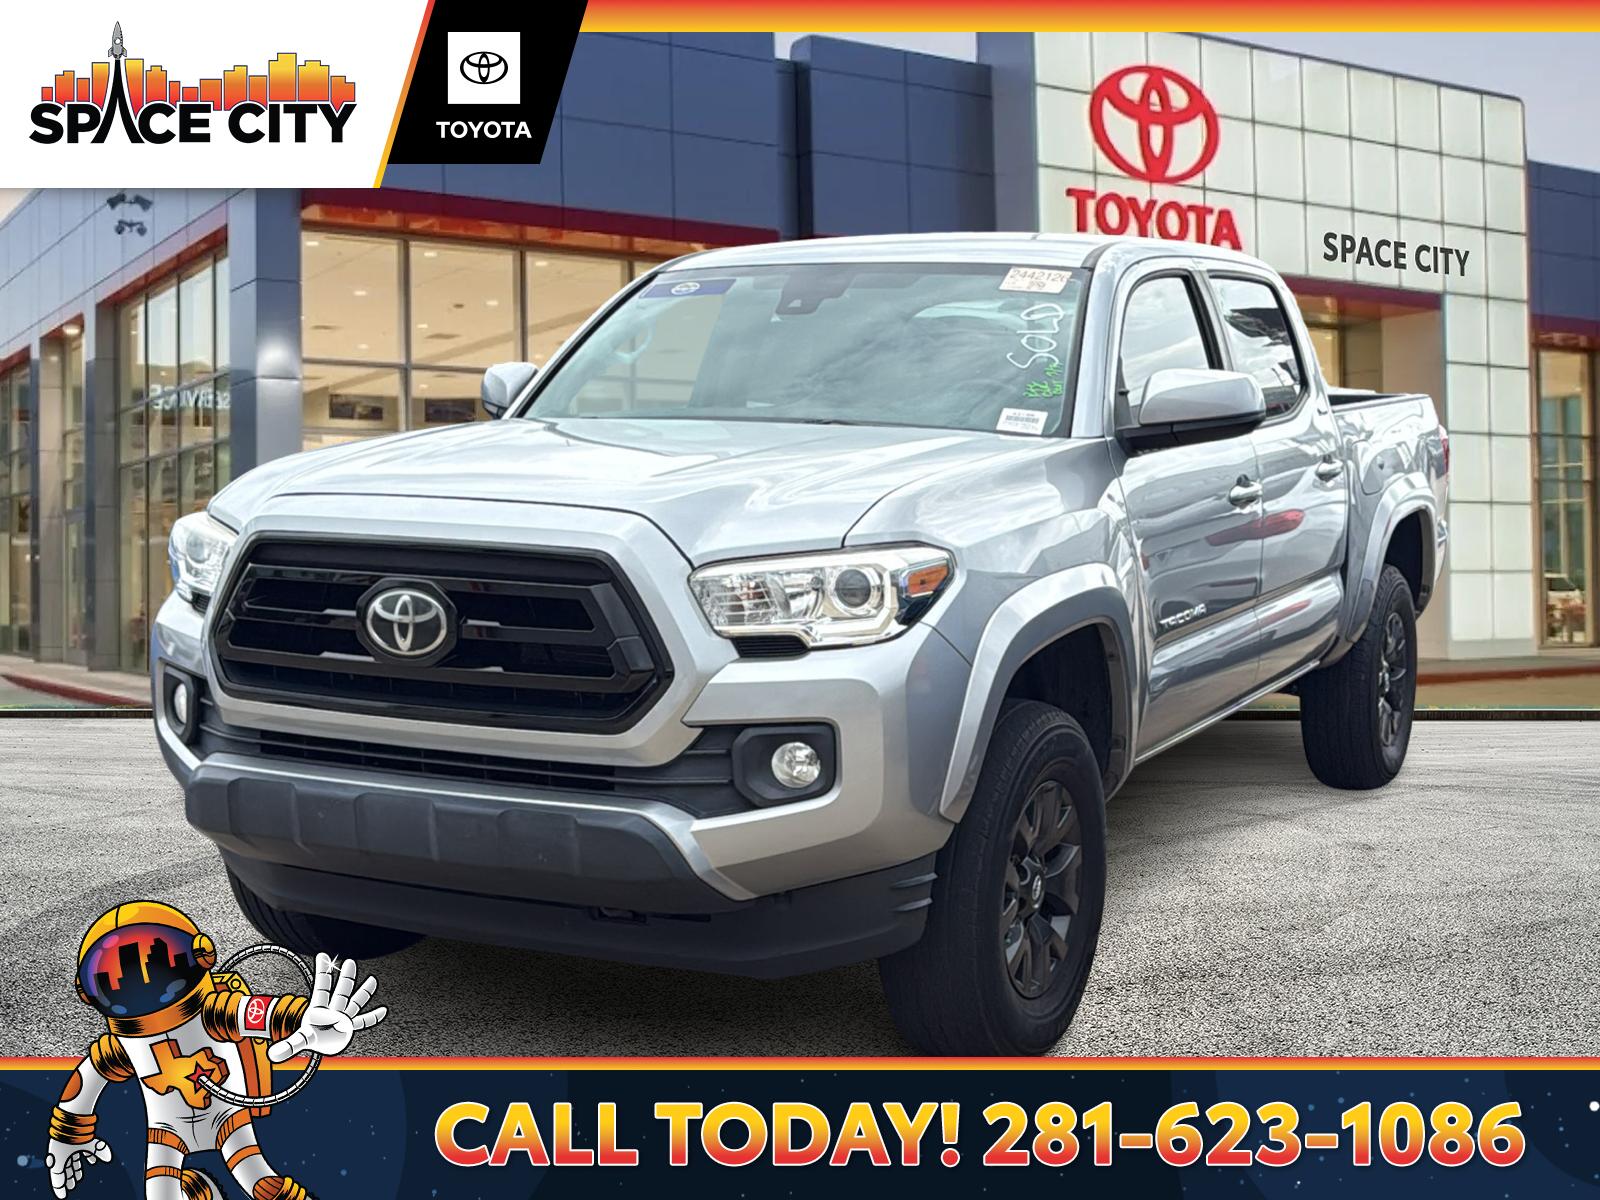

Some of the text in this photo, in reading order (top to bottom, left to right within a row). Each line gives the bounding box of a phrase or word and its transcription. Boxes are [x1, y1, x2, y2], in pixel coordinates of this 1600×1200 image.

[1066, 187, 1243, 251] TOYOTA
[1323, 231, 1471, 277] SPACE CITY
[1006, 302, 1065, 369] SOLD
[1159, 602, 1207, 628] TACOMA
